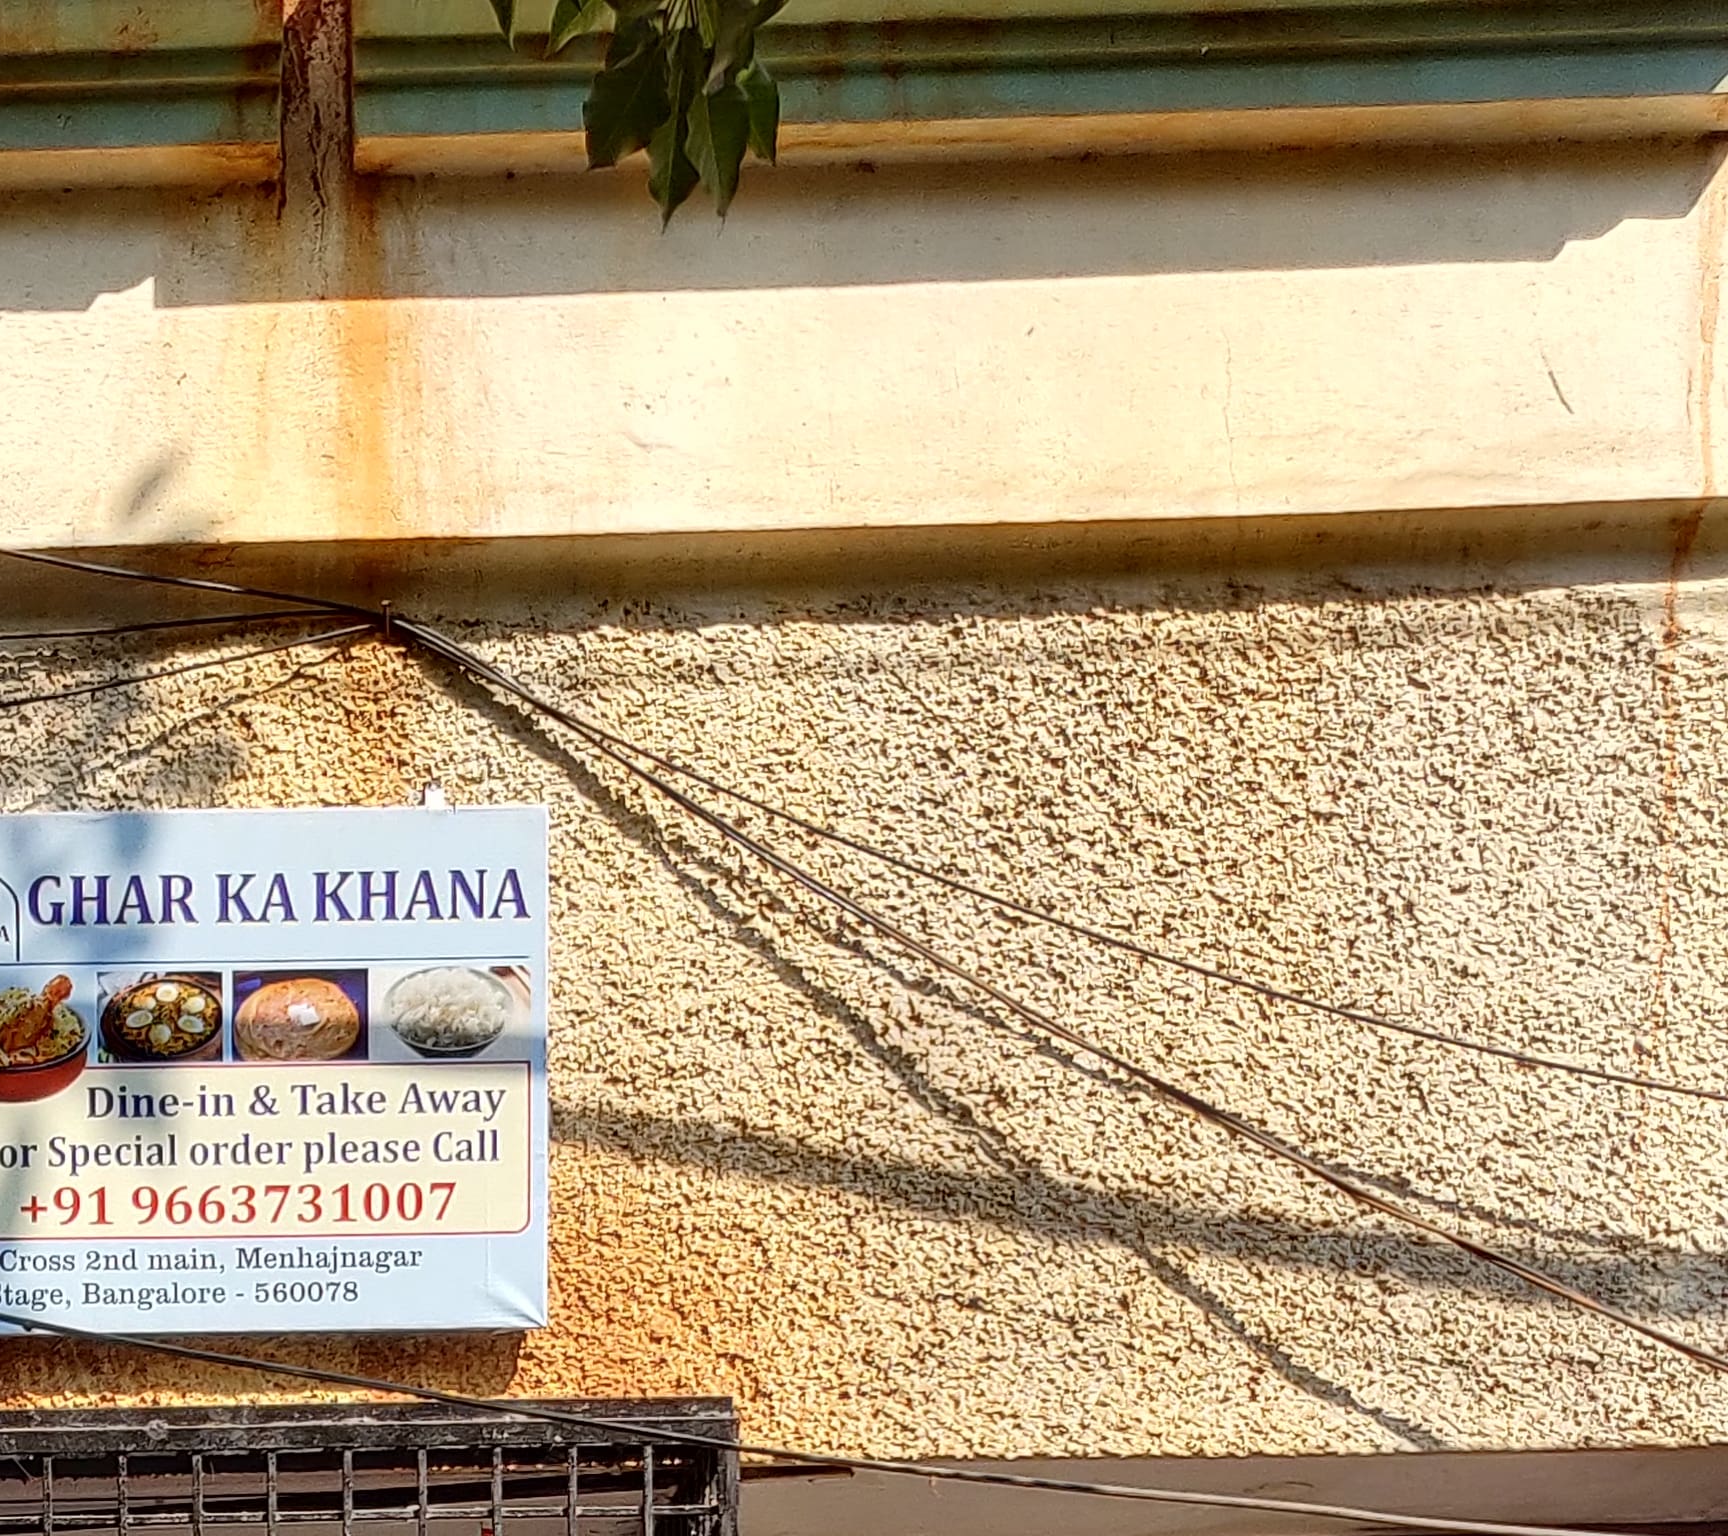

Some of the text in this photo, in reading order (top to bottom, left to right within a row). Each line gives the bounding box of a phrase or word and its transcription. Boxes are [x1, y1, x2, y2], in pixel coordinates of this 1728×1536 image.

[29, 868, 531, 926] GHAR KA KHANA
[86, 1082, 508, 1122] Dine-in & Take Away
[47, 1133, 178, 1176] Special
[189, 1133, 294, 1167] order
[303, 1131, 421, 1173] please
[432, 1129, 500, 1163] Call
[20, 1181, 458, 1226] +91 9663731007
[85, 1248, 138, 1271] 2nd
[147, 1247, 226, 1274] main,
[235, 1245, 423, 1274] Menhajnagar
[81, 1281, 227, 1311] Bangalore
[254, 1281, 359, 1304] 560078
